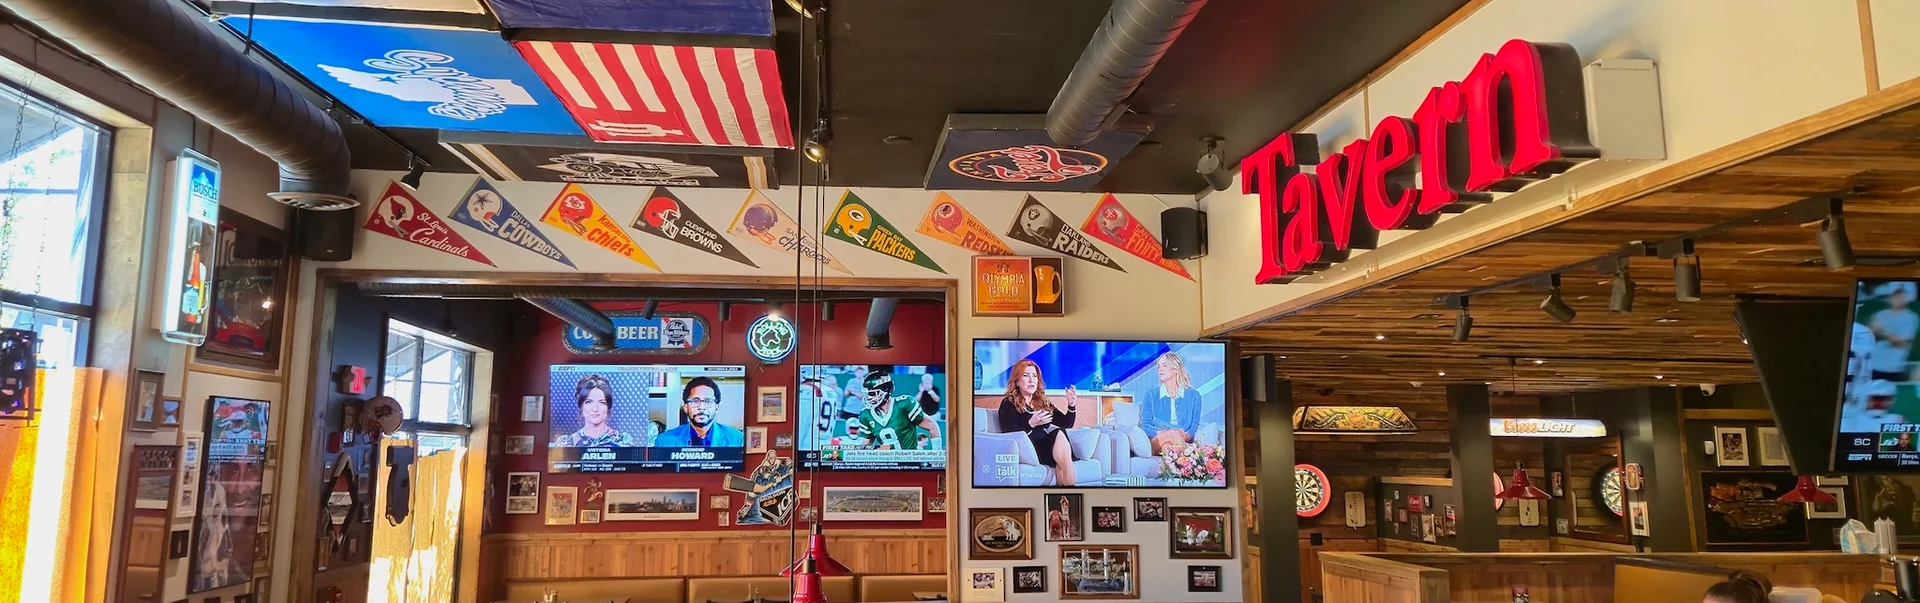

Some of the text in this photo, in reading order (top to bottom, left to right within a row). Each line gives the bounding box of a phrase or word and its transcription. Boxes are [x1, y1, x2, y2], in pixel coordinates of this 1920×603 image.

[1241, 38, 1561, 285] Tavern
[193, 181, 218, 200] BUSCH
[428, 220, 449, 235] Louis
[510, 210, 532, 229] DALLAS
[497, 219, 563, 260] COWBOYS
[685, 220, 718, 240] CLEVELAND
[966, 217, 1001, 245] WASHINGTON
[1061, 223, 1091, 247] OAKLAND
[409, 227, 469, 258] Cardinals
[586, 227, 635, 257] Chiefs
[679, 226, 723, 254] BROWNS
[866, 229, 916, 261] PACKERS
[1052, 234, 1110, 265] RAIDERS
[1126, 231, 1162, 261] FORTY
[982, 271, 1026, 285] OLYMPIA
[988, 285, 1019, 297] GOLD
[617, 326, 659, 340] BEER
[1503, 418, 1575, 433] Coors LIGHT
[1883, 424, 1913, 432] FIRST
[1853, 437, 1871, 446] SC
[671, 452, 715, 460] HOWARD
[1848, 453, 1872, 461] ESPN
